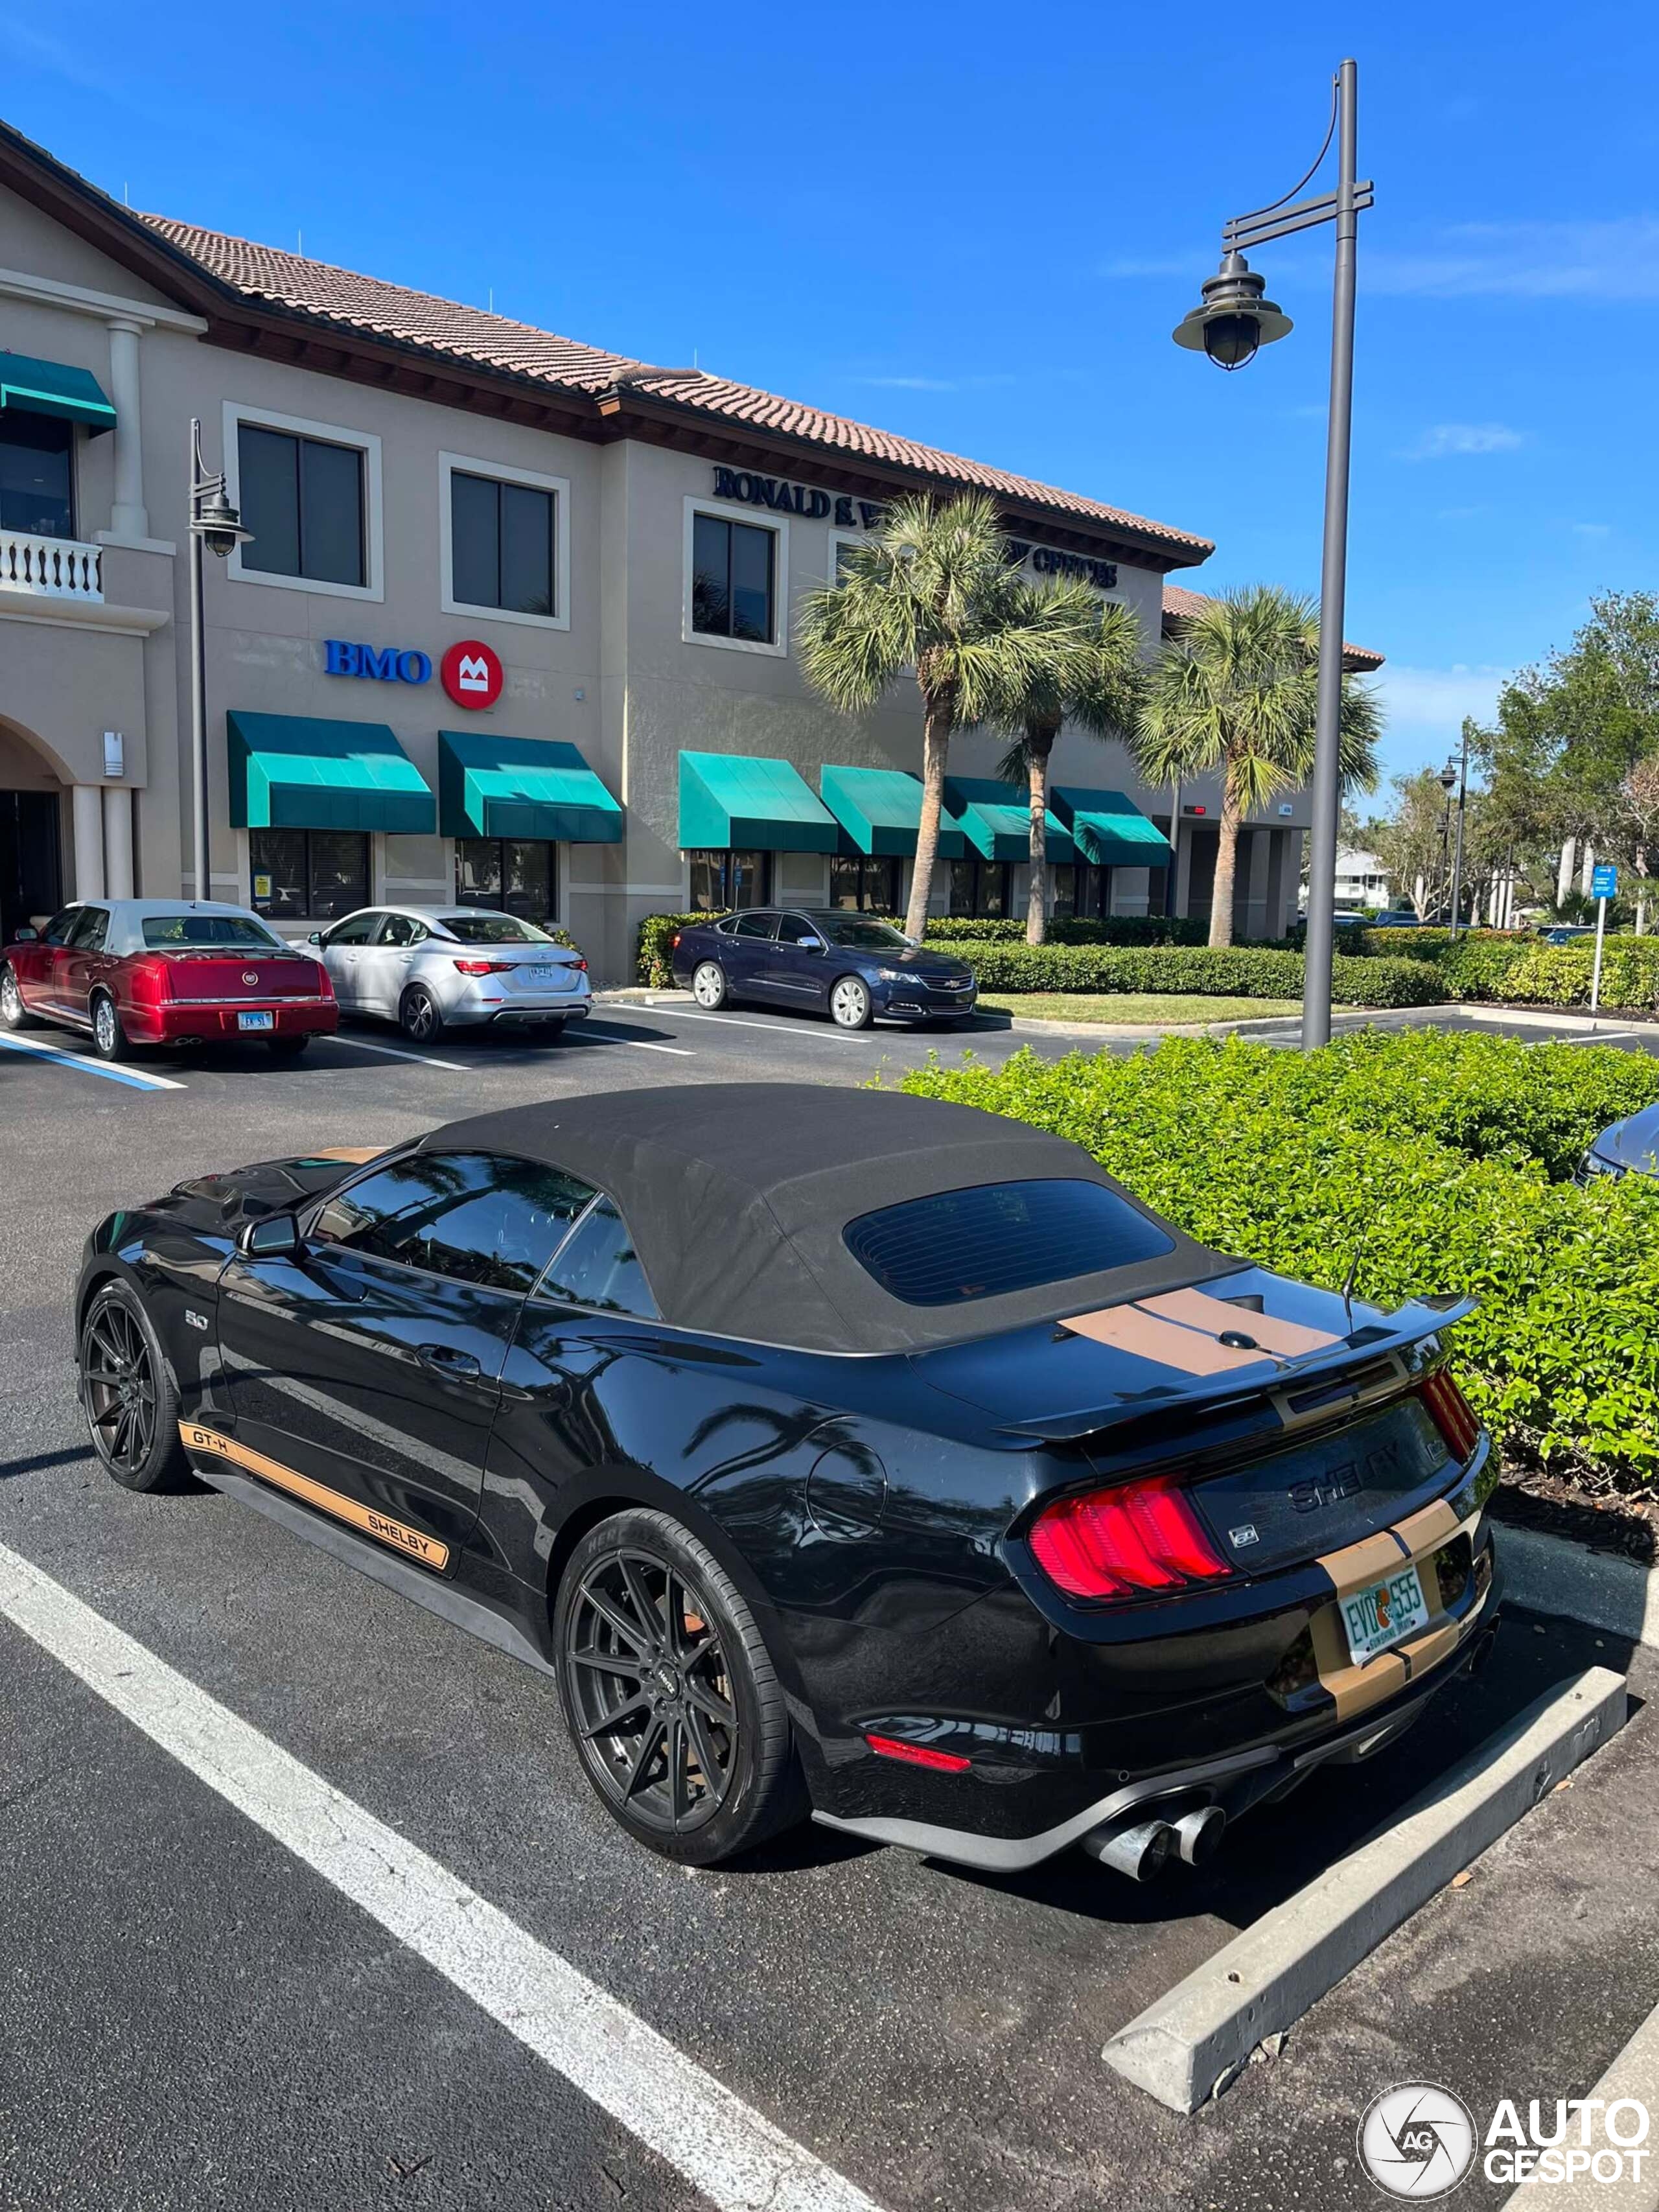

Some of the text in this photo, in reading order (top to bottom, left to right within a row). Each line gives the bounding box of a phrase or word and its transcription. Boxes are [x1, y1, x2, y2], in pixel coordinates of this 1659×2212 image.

[713, 466, 831, 519] RONALD
[324, 639, 432, 684] BMO
[193, 1430, 229, 1452] GT-H
[368, 1515, 428, 1554] SHELBY
[658, 1670, 675, 1694] Hertz
